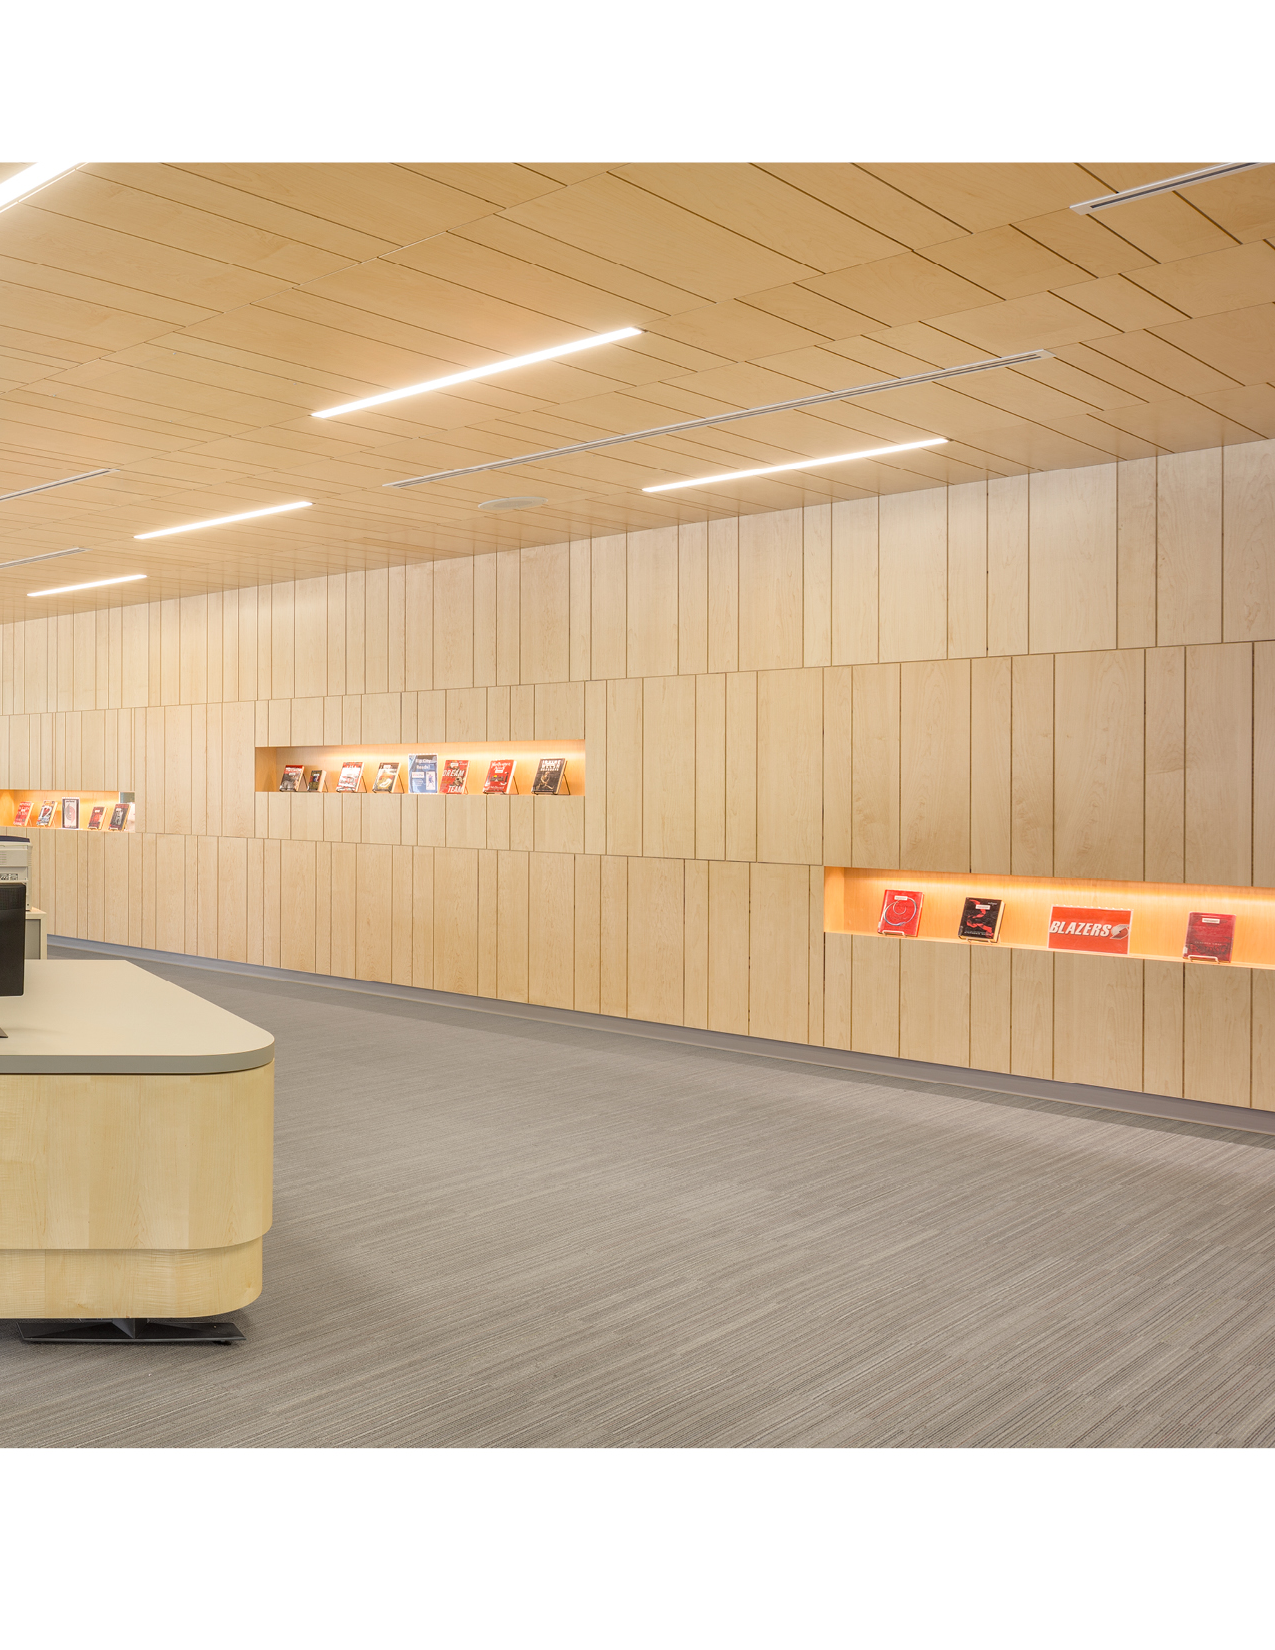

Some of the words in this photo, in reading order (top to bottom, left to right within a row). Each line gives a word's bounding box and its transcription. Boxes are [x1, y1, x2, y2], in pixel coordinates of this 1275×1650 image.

[442, 769, 465, 777] DREAM
[447, 785, 464, 793] TEAM
[1049, 921, 1112, 937] BLAZERS
